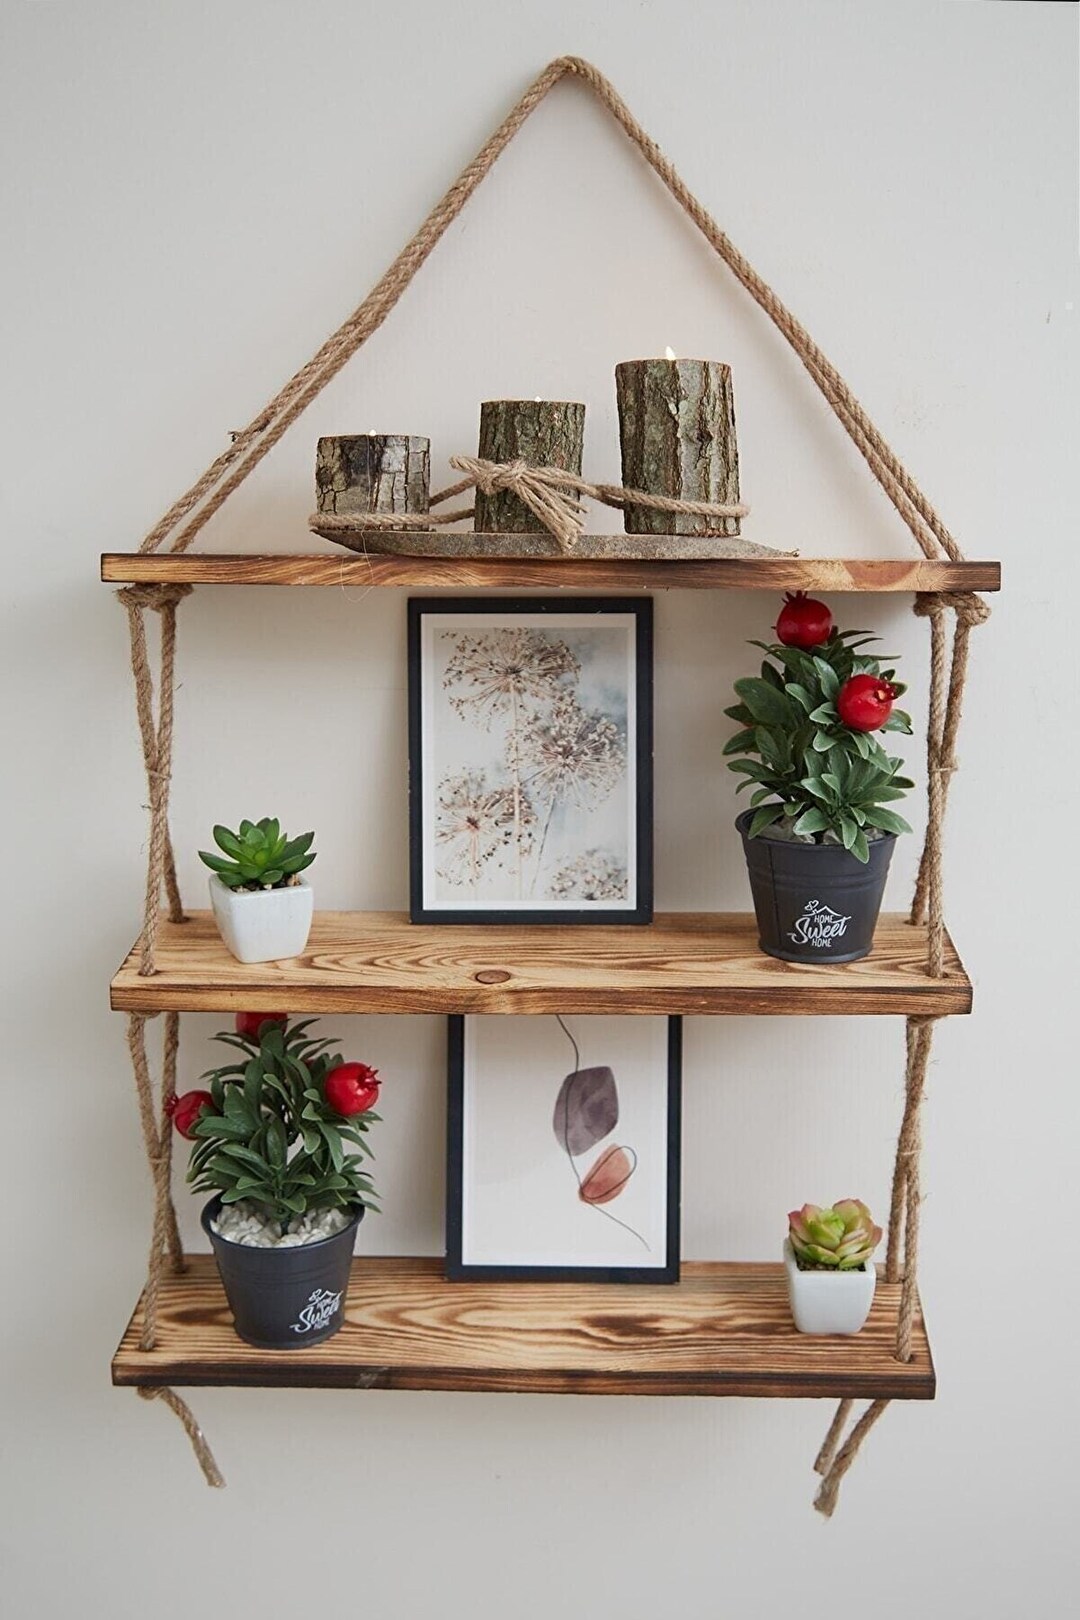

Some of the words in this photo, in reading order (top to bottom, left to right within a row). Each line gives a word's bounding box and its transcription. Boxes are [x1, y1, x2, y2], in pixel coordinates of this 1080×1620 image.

[814, 915, 834, 923] HOME
[787, 916, 852, 944] Sweet
[811, 938, 832, 947] HOME
